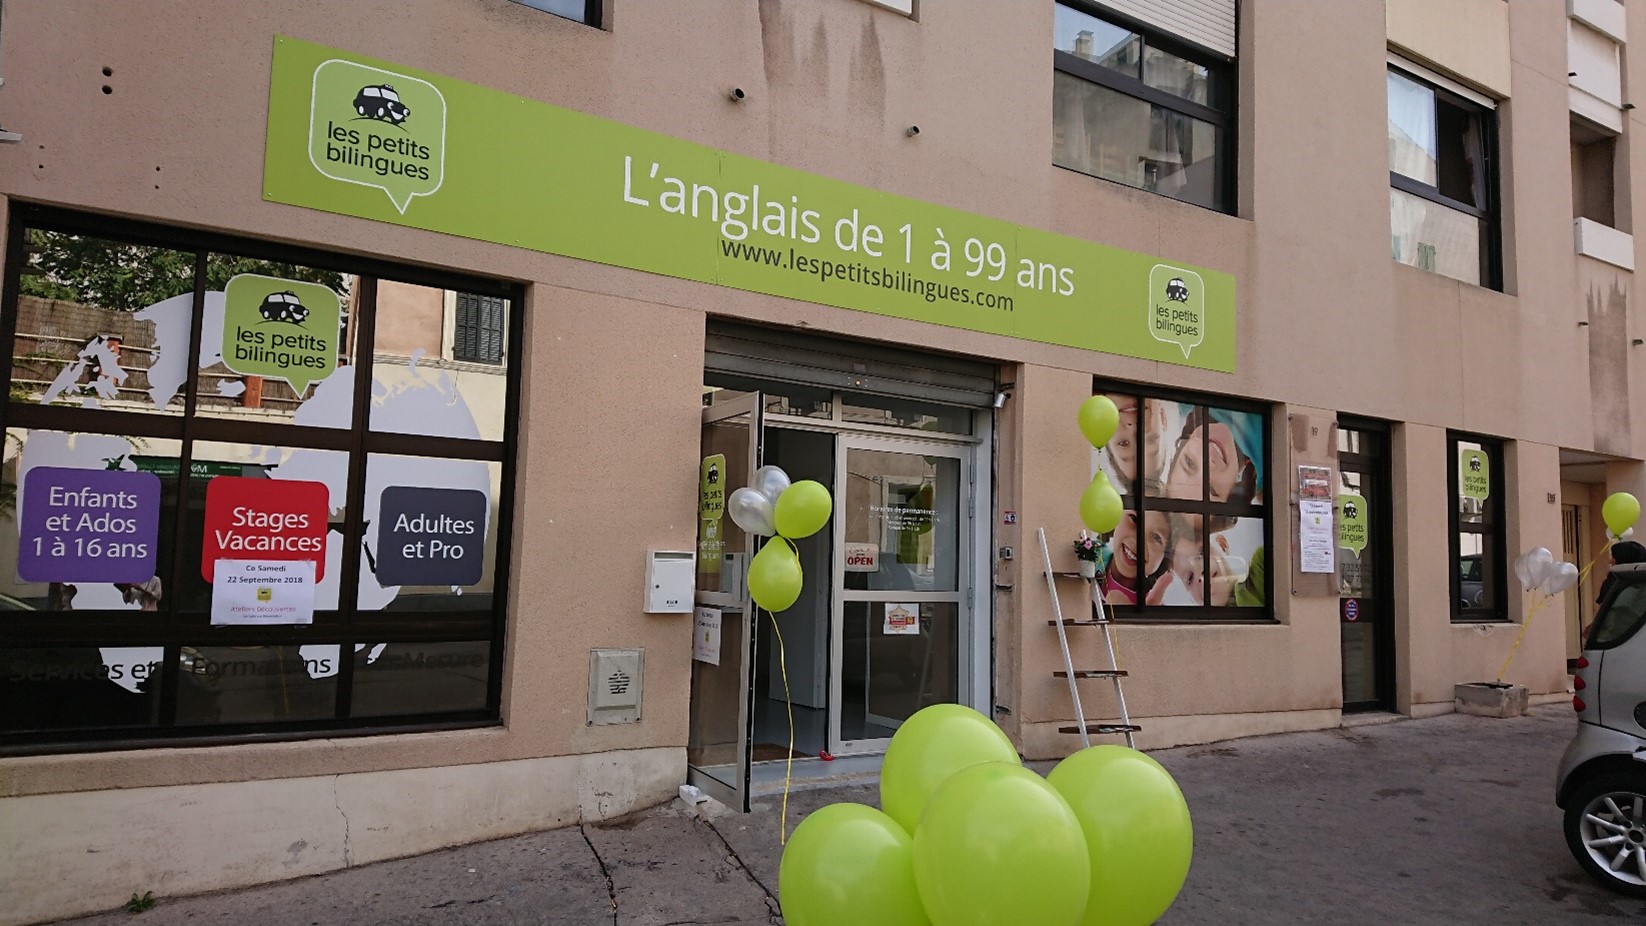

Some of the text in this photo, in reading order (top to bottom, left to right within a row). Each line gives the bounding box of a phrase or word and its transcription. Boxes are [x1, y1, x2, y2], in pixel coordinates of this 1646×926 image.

[326, 120, 430, 160] les petits
[326, 142, 430, 180] bilingues
[623, 155, 1075, 296] L'anglais de 1 à 99 ans
[721, 239, 1014, 312] www.lespetitsbilingues.com
[1156, 303, 1198, 323] les petits
[1156, 317, 1198, 336] bilingues
[236, 326, 326, 351] les petits
[235, 344, 326, 369] bilingues
[49, 486, 138, 510] Enfants
[45, 512, 136, 533] et Ados
[232, 506, 309, 533] Stages
[393, 513, 475, 535] Adultes
[33, 536, 148, 558] 1 à 16 ans
[215, 529, 322, 552] Vacances
[402, 540, 464, 560] et Pro
[847, 556, 874, 566] OPEN
[227, 576, 237, 584] 22
[239, 576, 282, 585] Septembre
[131, 660, 156, 679] et
